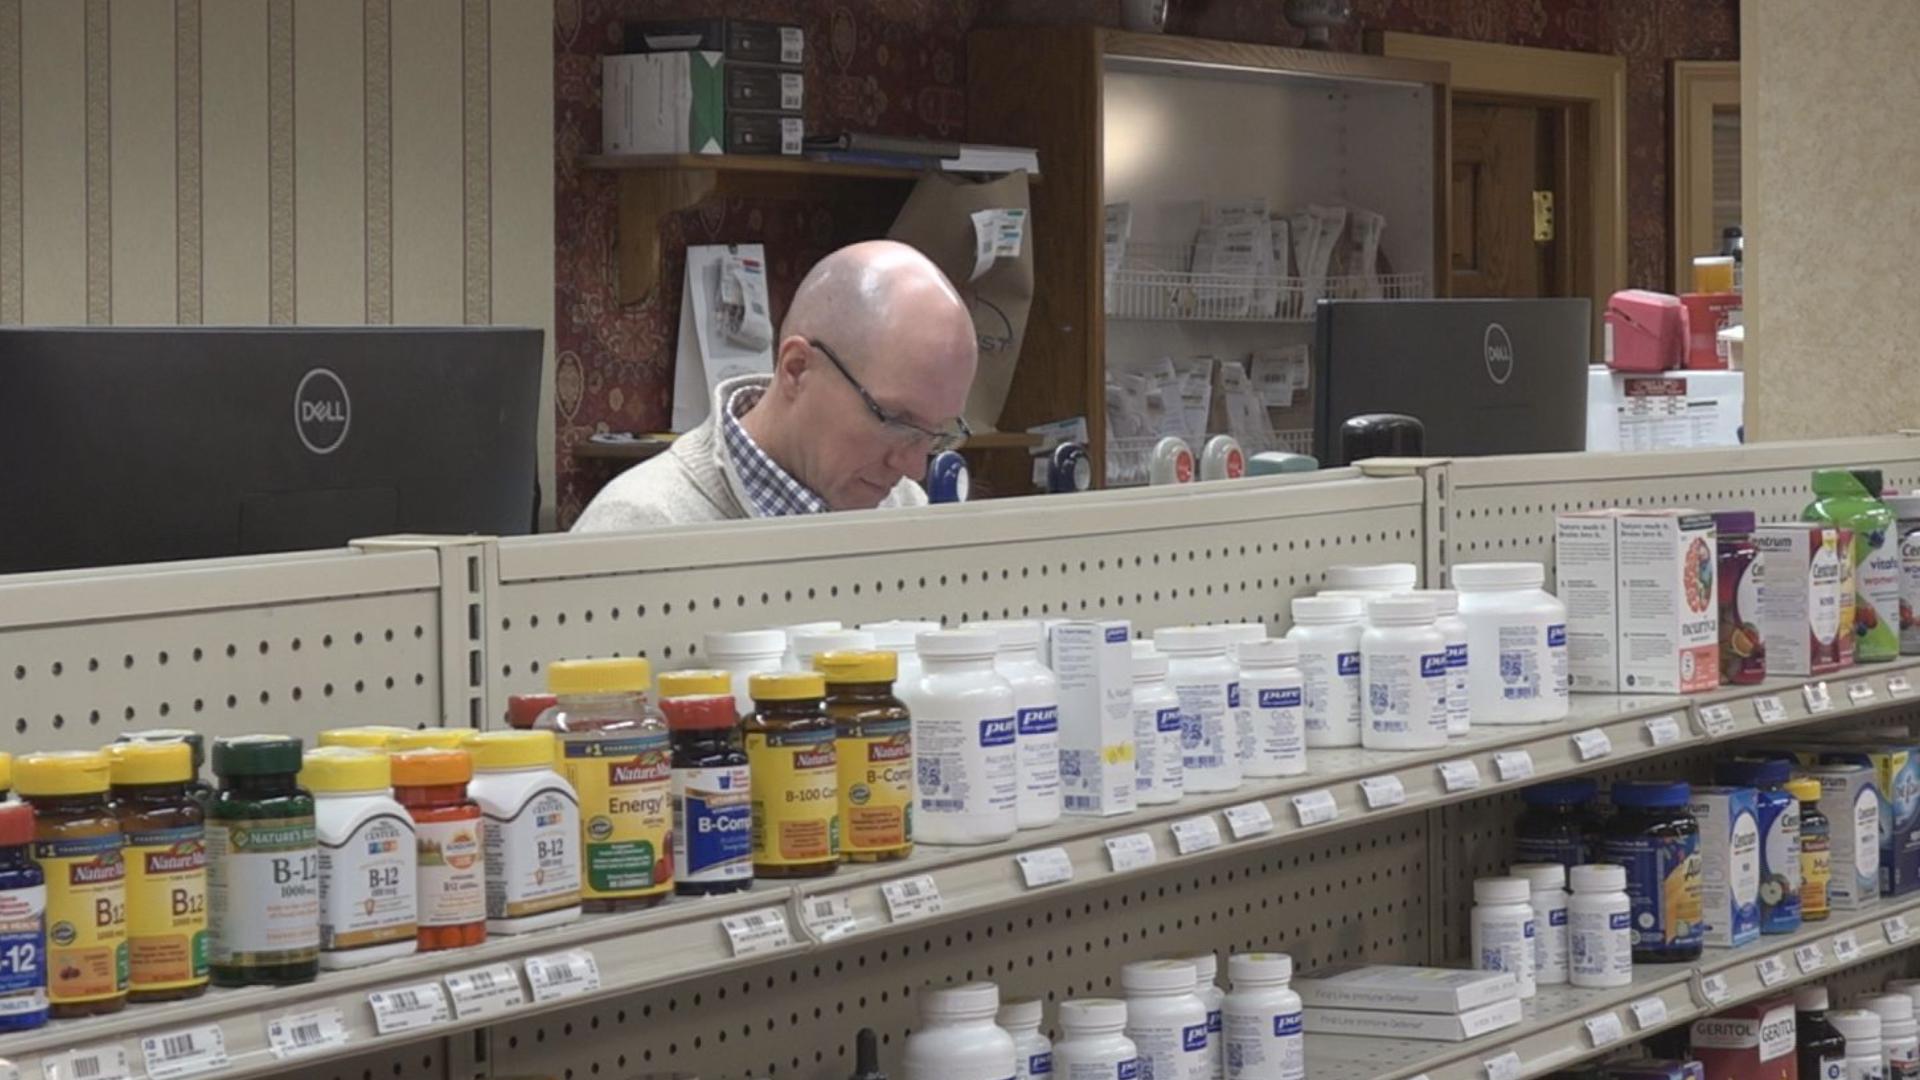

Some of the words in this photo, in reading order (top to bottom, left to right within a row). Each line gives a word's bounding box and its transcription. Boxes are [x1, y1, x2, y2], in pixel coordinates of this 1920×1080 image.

[302, 401, 345, 421] DELL
[1263, 690, 1299, 700] pure
[608, 794, 664, 815] Energy
[537, 838, 564, 859] B-12
[369, 866, 400, 888] B-12
[172, 888, 204, 916] B12
[0, 942, 36, 973] -12
[1697, 1022, 1754, 1037] GERITOL
[1762, 1018, 1794, 1042] GERITOL
